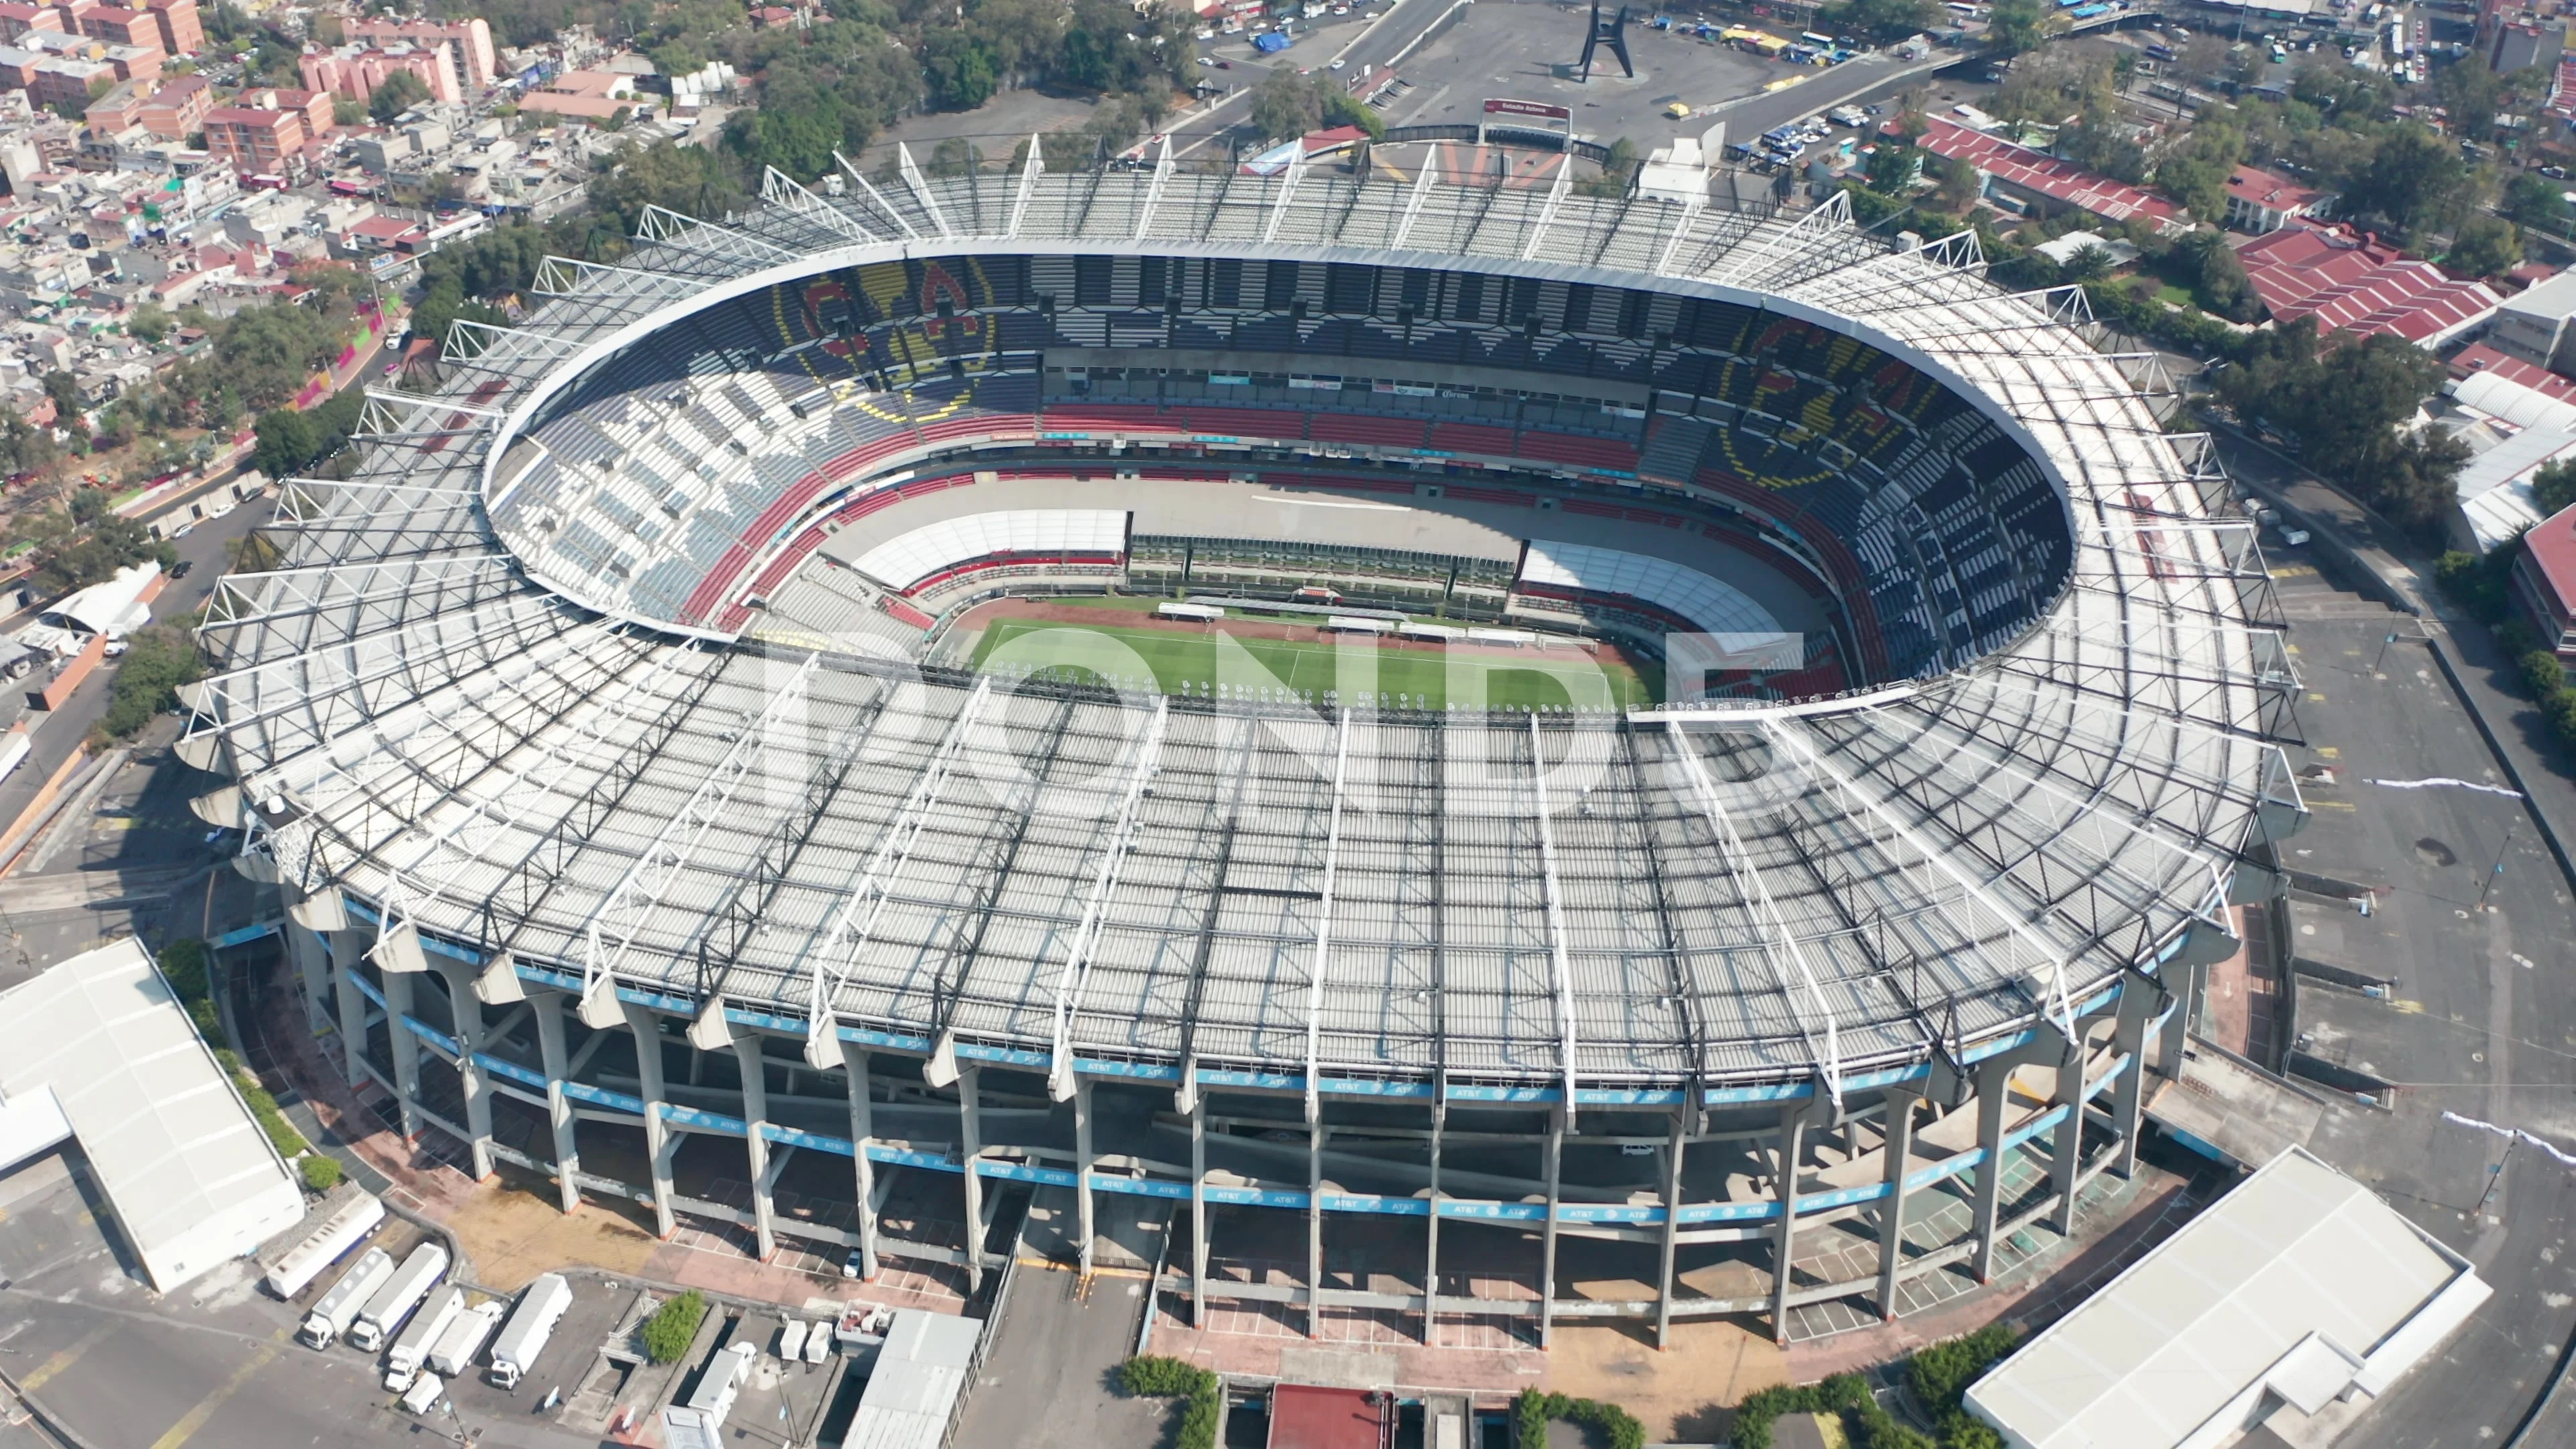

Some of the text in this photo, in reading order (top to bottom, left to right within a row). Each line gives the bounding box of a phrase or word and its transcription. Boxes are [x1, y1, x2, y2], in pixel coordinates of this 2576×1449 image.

[1502, 103, 1523, 111] Estadio
[1525, 105, 1546, 113] Azteca
[628, 993, 649, 1004] AT&T
[737, 1014, 759, 1023] AT&T
[851, 1031, 873, 1040] AT&T
[966, 1048, 990, 1058] AT&T
[1087, 1063, 1111, 1072] AT&T
[1209, 1073, 1232, 1083] AT&T
[1335, 1082, 1360, 1091] AT&T
[1455, 1089, 1481, 1097] AT&T
[1584, 1093, 1609, 1102] AT&T
[1711, 1091, 1737, 1101] AT&T
[672, 1112, 692, 1121] AT&T
[720, 1120, 741, 1131] AT&T
[824, 1141, 846, 1151] AT&T
[880, 1152, 902, 1161] AT&T
[989, 1166, 1011, 1175] AT&T
[1044, 1173, 1068, 1182] AT&T
[1102, 1180, 1125, 1189] AT&T
[1158, 1186, 1181, 1195] AT&T
[1857, 1188, 1879, 1199] AT&T
[1217, 1191, 1240, 1200] AT&T
[1274, 1195, 1297, 1204] AT&T
[1334, 1199, 1358, 1208] AT&T
[1391, 1201, 1416, 1211] AT&T
[1803, 1197, 1826, 1208] AT&T
[1454, 1205, 1478, 1214] AT&T
[1507, 1208, 1532, 1216] AT&T
[1569, 1210, 1594, 1218] AT&T
[1688, 1210, 1712, 1218] AT&T
[1746, 1206, 1769, 1216] AT&T
[1627, 1211, 1652, 1220] AT&T
